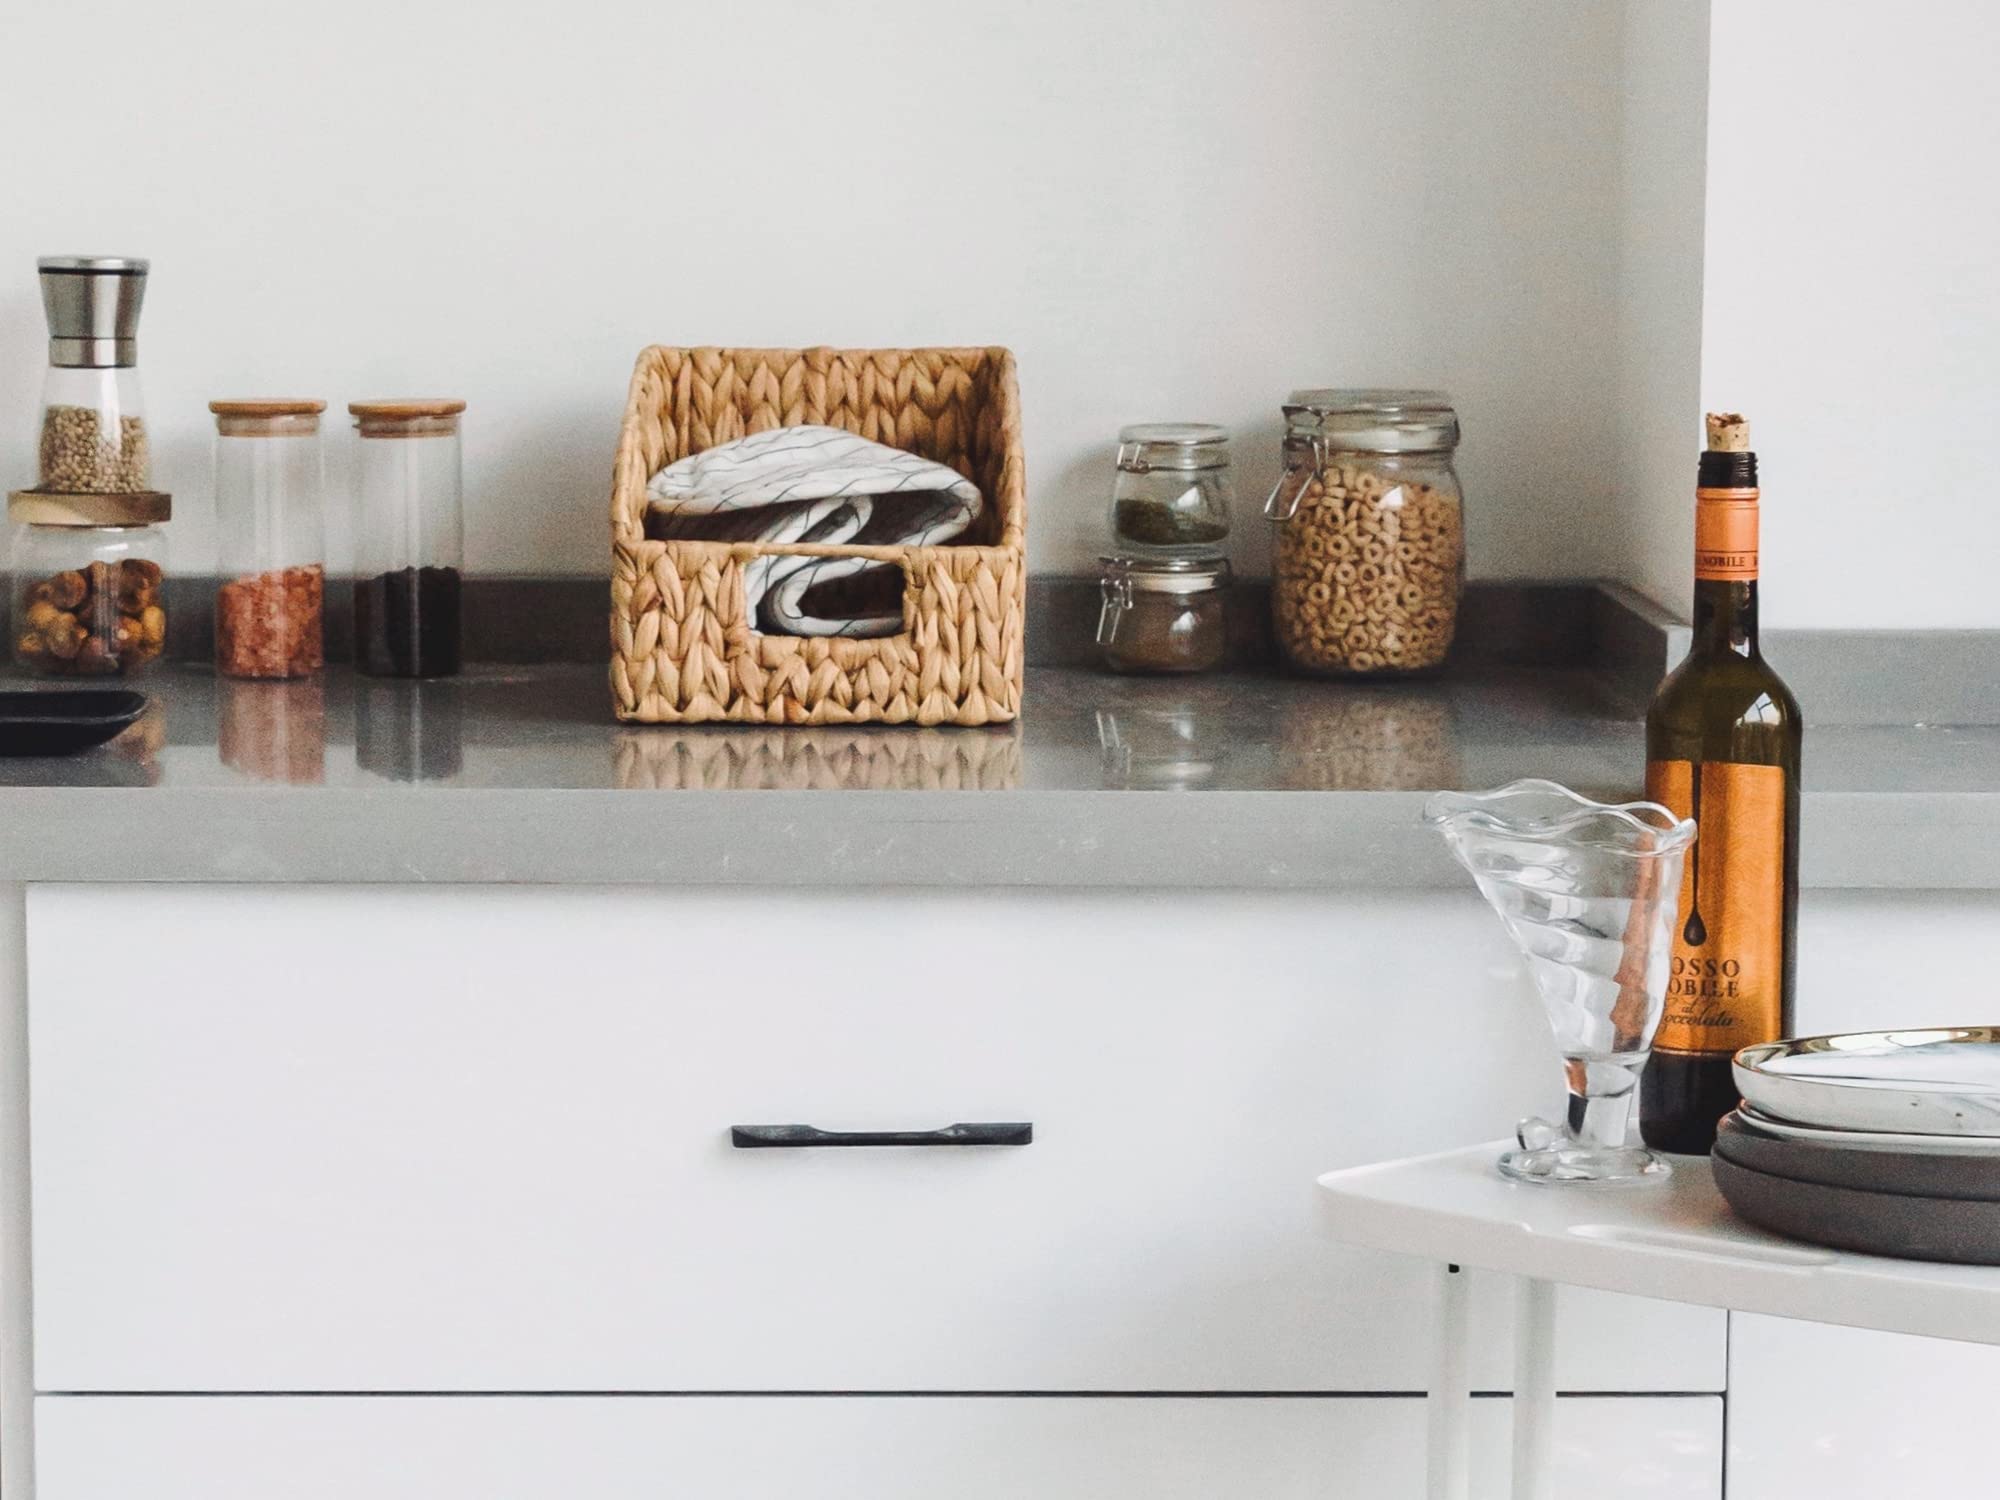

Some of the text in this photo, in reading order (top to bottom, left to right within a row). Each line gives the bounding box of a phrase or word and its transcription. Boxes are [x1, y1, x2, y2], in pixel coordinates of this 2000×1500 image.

[1703, 555, 1745, 567] NOBILE
[1671, 956, 1740, 978] OSSO
[1668, 978, 1740, 998] OBILE
